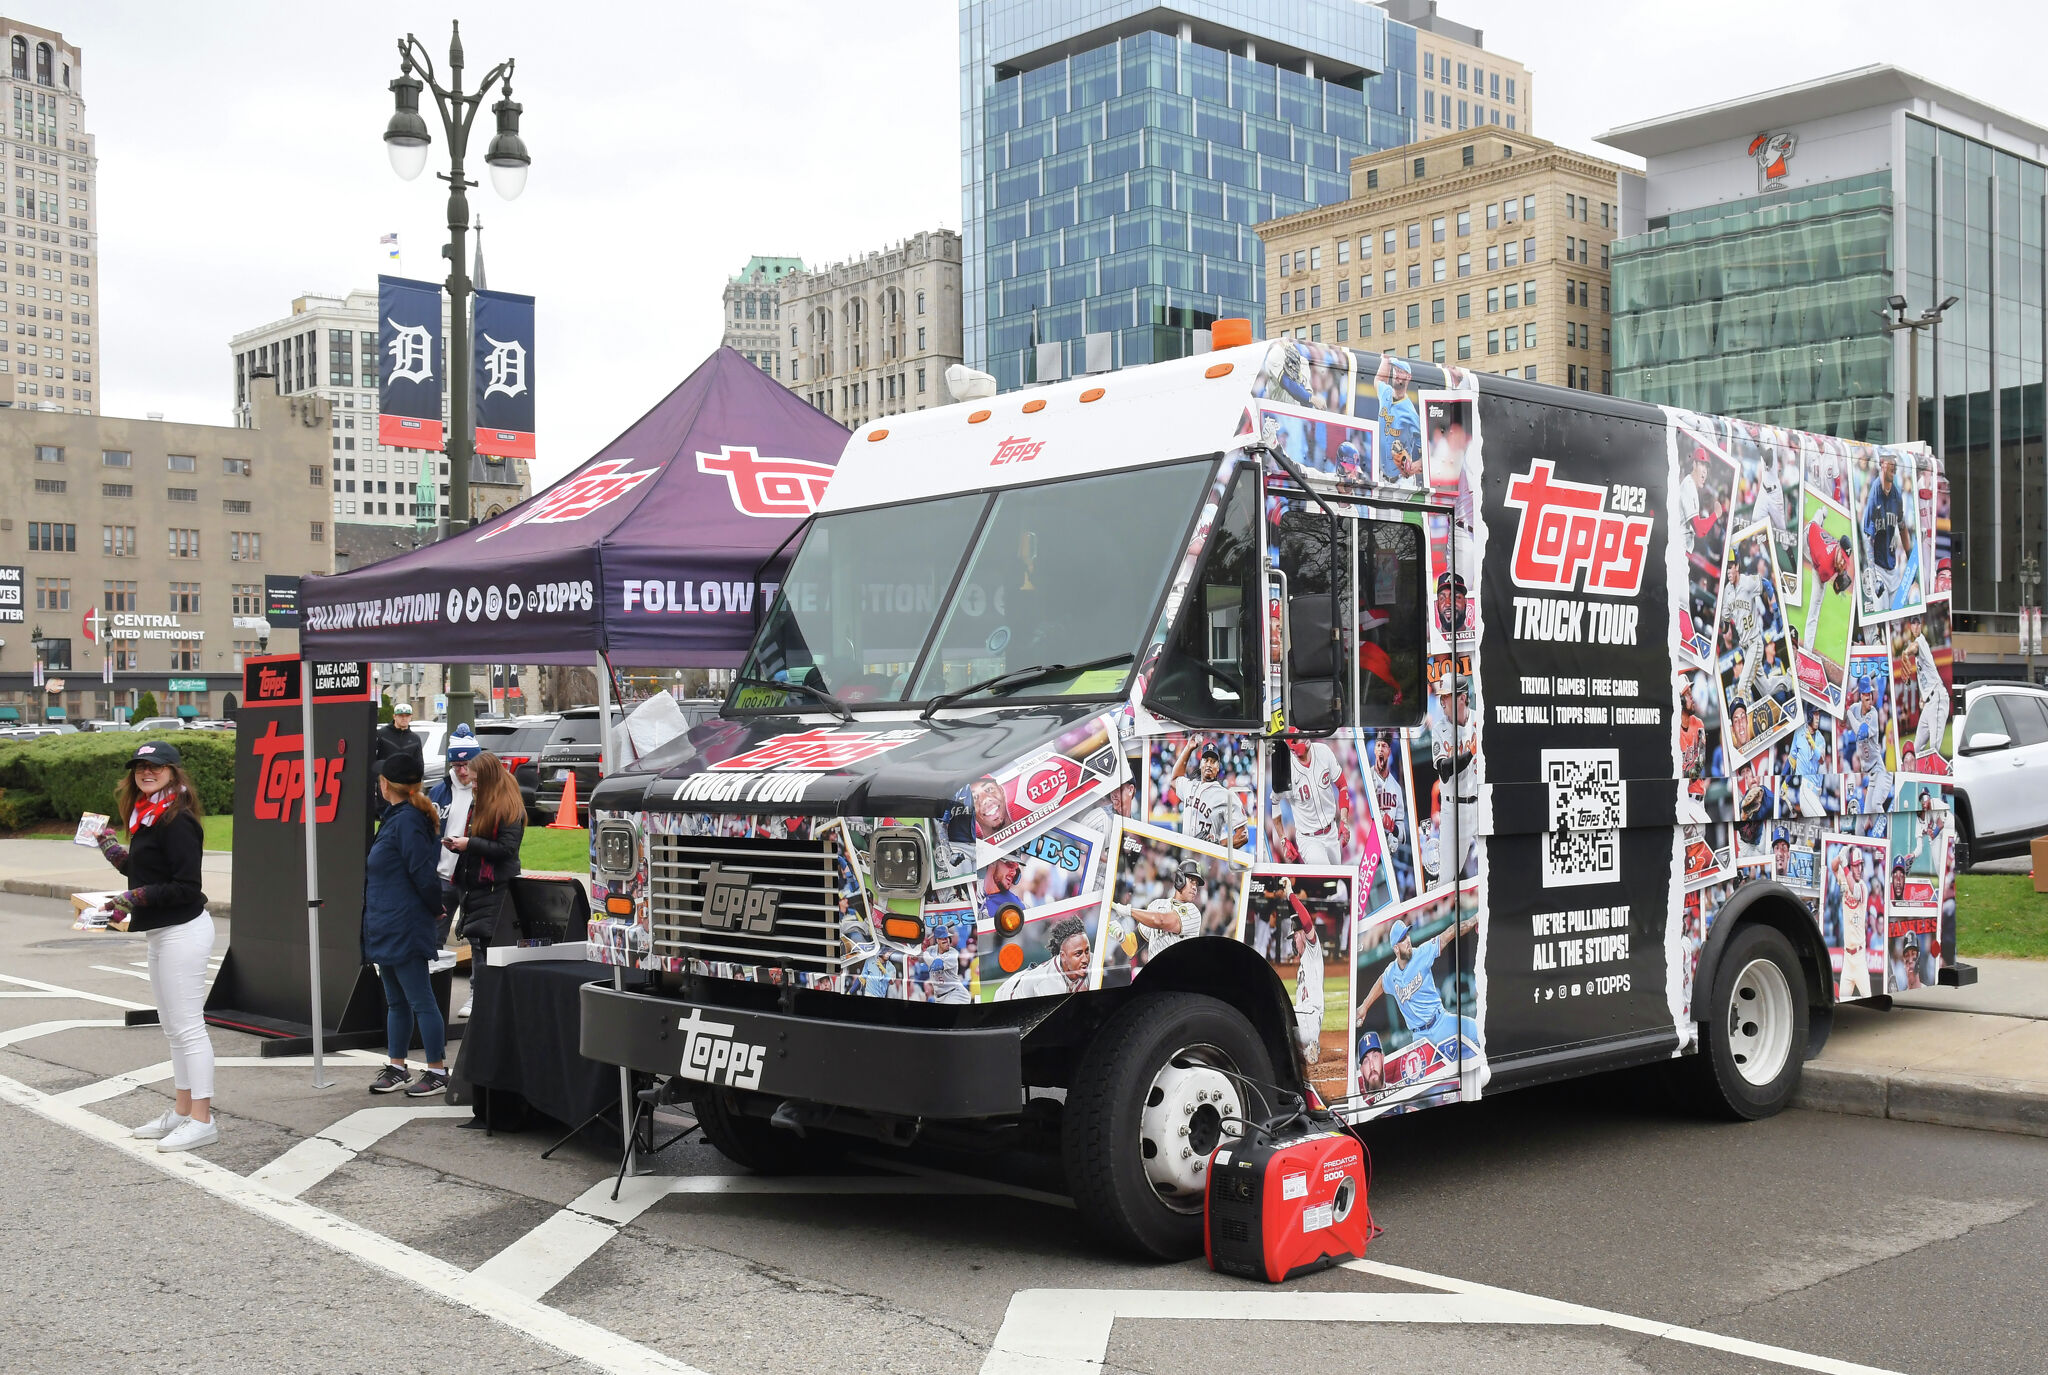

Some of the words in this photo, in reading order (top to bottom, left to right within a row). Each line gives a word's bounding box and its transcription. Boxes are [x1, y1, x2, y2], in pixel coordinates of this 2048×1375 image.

[1611, 484, 1647, 513] 2023
[622, 580, 754, 614] FOLLOW
[113, 614, 181, 627] CENTRAL
[307, 603, 356, 631] FOLLOW
[357, 600, 382, 628] THE
[382, 592, 440, 626] ACTION!
[1512, 597, 1585, 643] TRUCK
[1587, 602, 1639, 646] TOUR
[143, 630, 206, 640] METHODIST
[316, 664, 333, 675] TAKE
[333, 664, 338, 675] A
[315, 677, 335, 689] LEAVE
[335, 678, 341, 688] A
[341, 676, 360, 688] CARD
[1520, 677, 1550, 695] TRIVIA
[1557, 678, 1585, 696] GAMES
[1592, 679, 1612, 696] FREE
[1612, 680, 1639, 697] CARDS
[1495, 706, 1524, 724] TRADE
[1525, 706, 1549, 724] WALL
[1556, 707, 1583, 724] TOPPS
[1584, 707, 1608, 725] SWAG
[1615, 708, 1661, 725] GIVEAWAYS
[673, 773, 749, 801] TRUCK
[746, 773, 825, 802] TOUR
[1028, 769, 1068, 800] REDS
[1298, 784, 1311, 802] 19
[993, 818, 1028, 843] HUNTER
[1027, 800, 1060, 825] GREENE
[1532, 911, 1566, 937] WE'RE
[1567, 908, 1611, 933] PULLING
[1611, 905, 1631, 928] OUT
[1532, 942, 1557, 971] ALL
[1558, 938, 1584, 968] THE
[1585, 933, 1630, 964] STOPS!
[1323, 1155, 1357, 1169] PREDATOR
[1323, 1170, 1344, 1182] 2000
